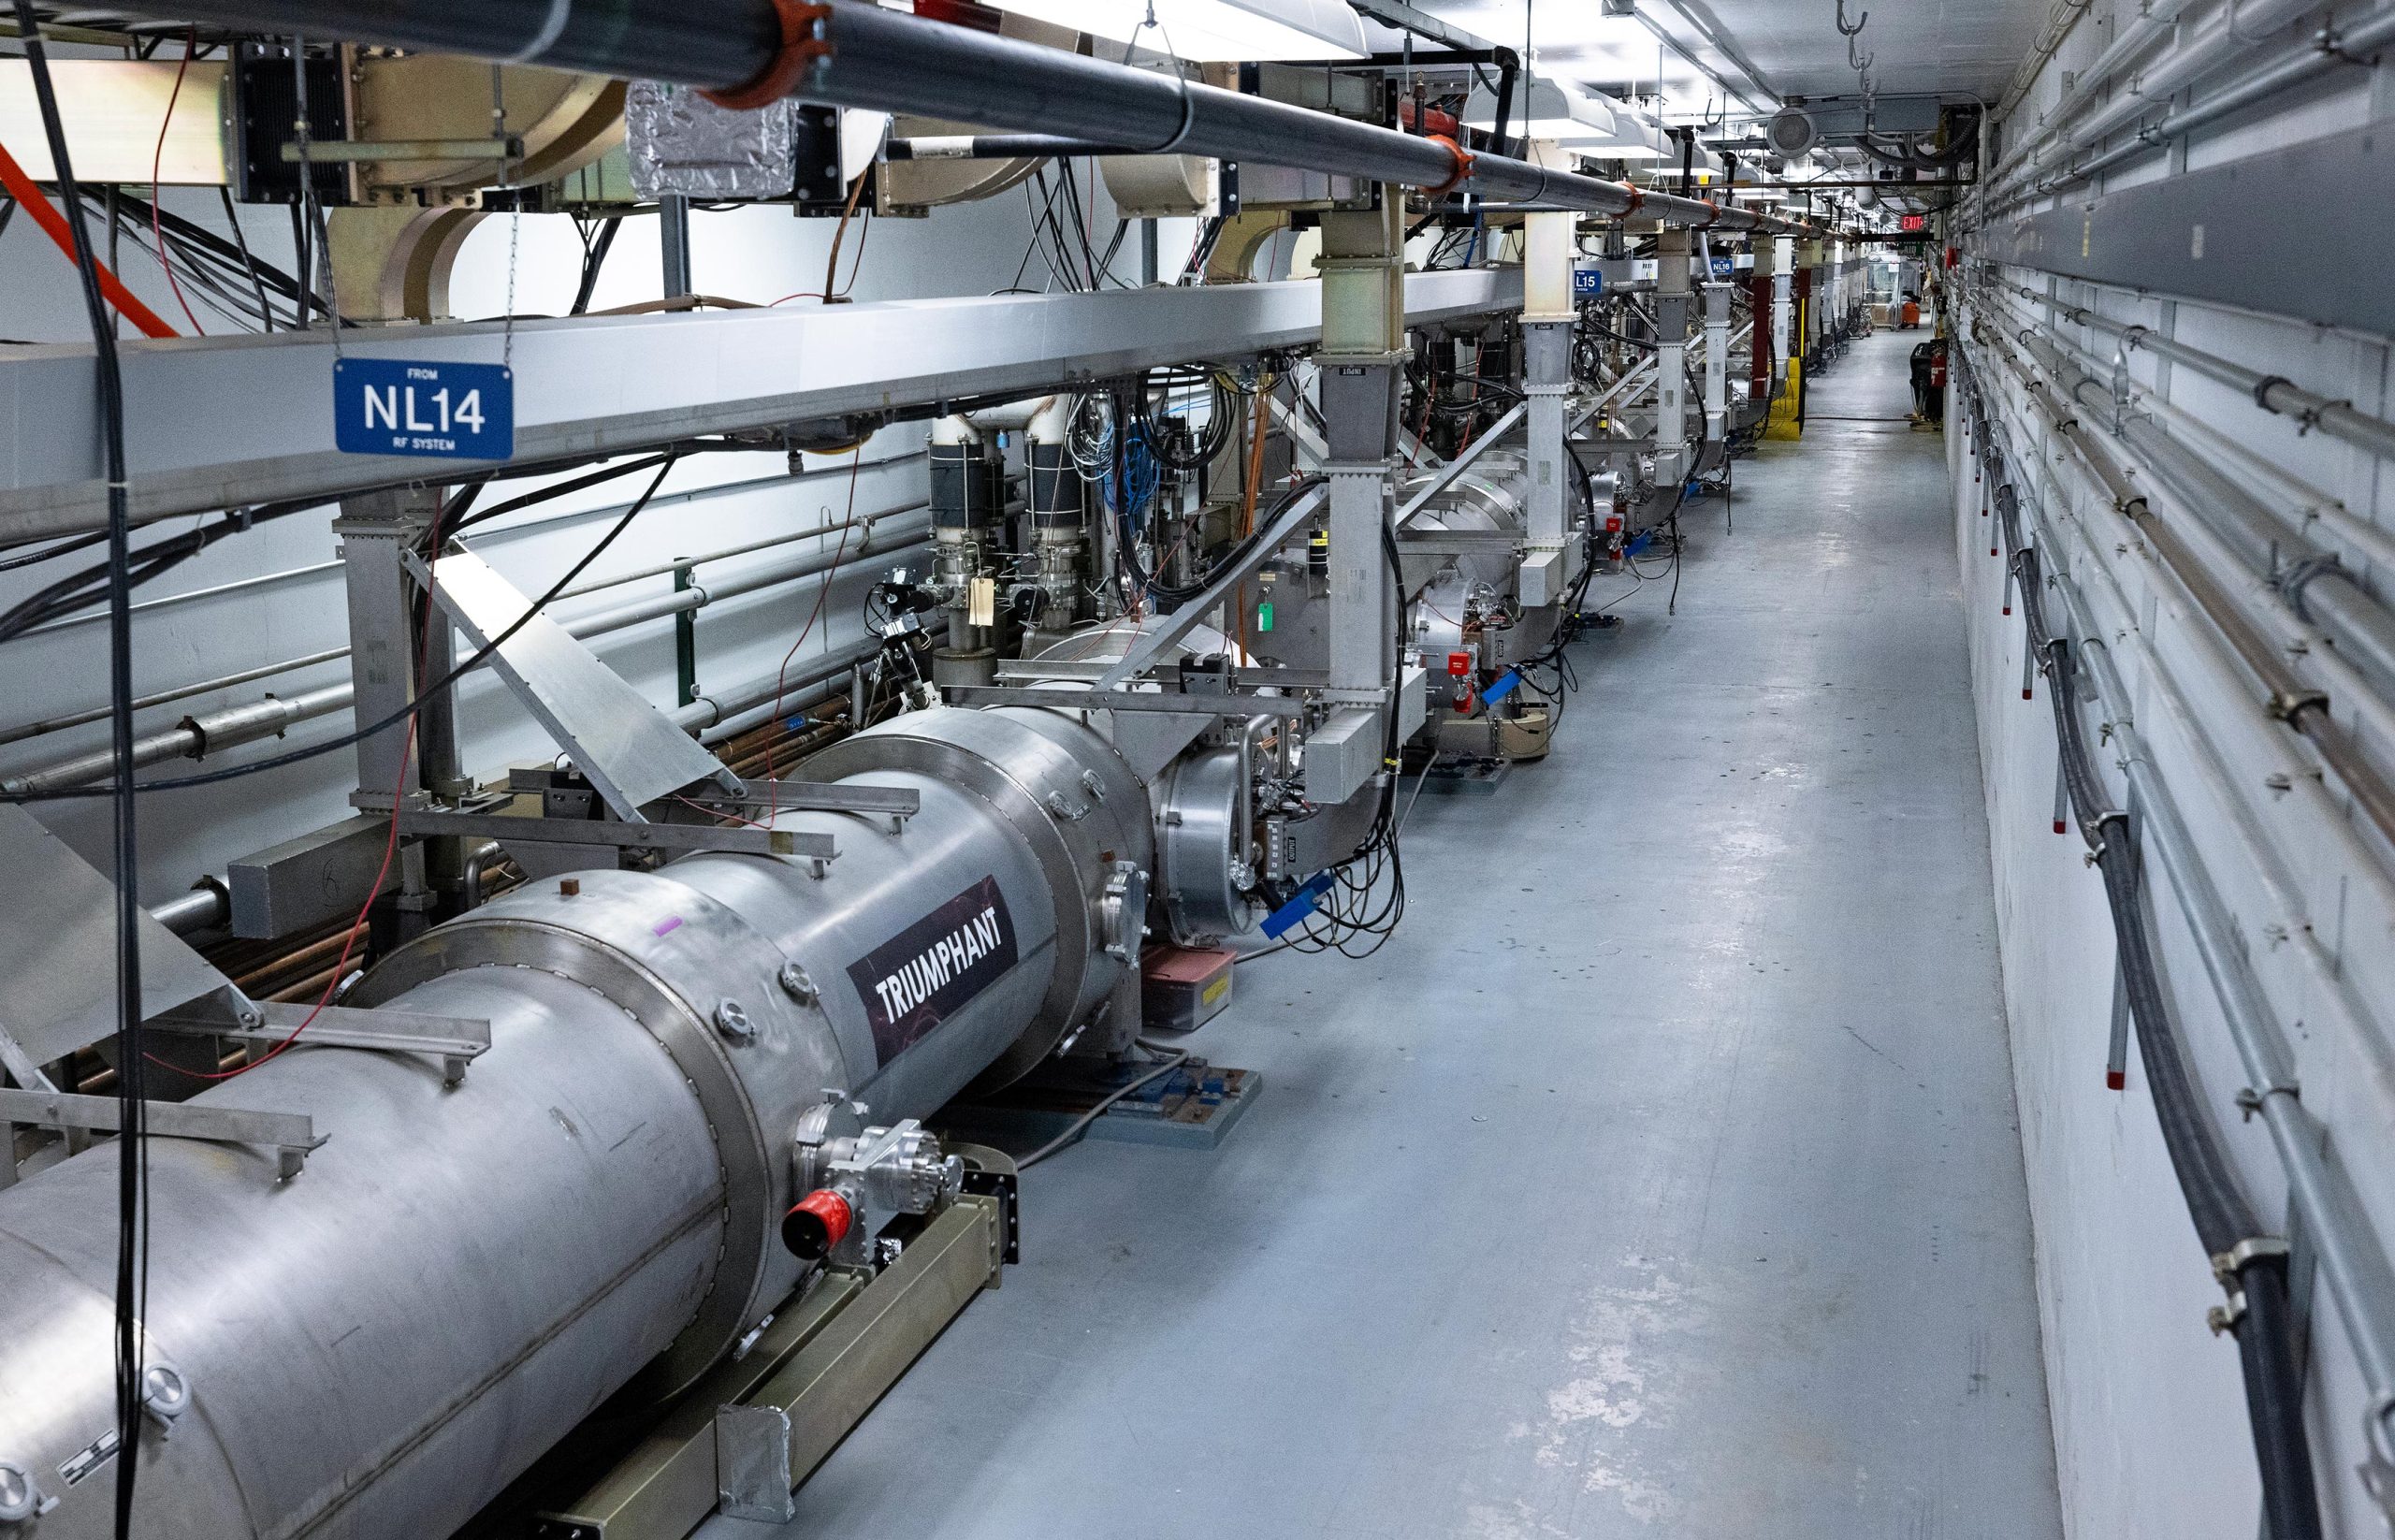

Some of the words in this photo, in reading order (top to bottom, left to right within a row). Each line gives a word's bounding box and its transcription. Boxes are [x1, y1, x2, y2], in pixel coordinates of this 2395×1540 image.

[1903, 216, 1921, 229] EXIT
[1575, 276, 1595, 287] L15
[407, 368, 439, 380] FROM
[364, 385, 486, 434] NL14
[392, 437, 408, 449] RF
[412, 438, 456, 451] SYSTEM
[875, 906, 1002, 1024] TRIUMPHANT
